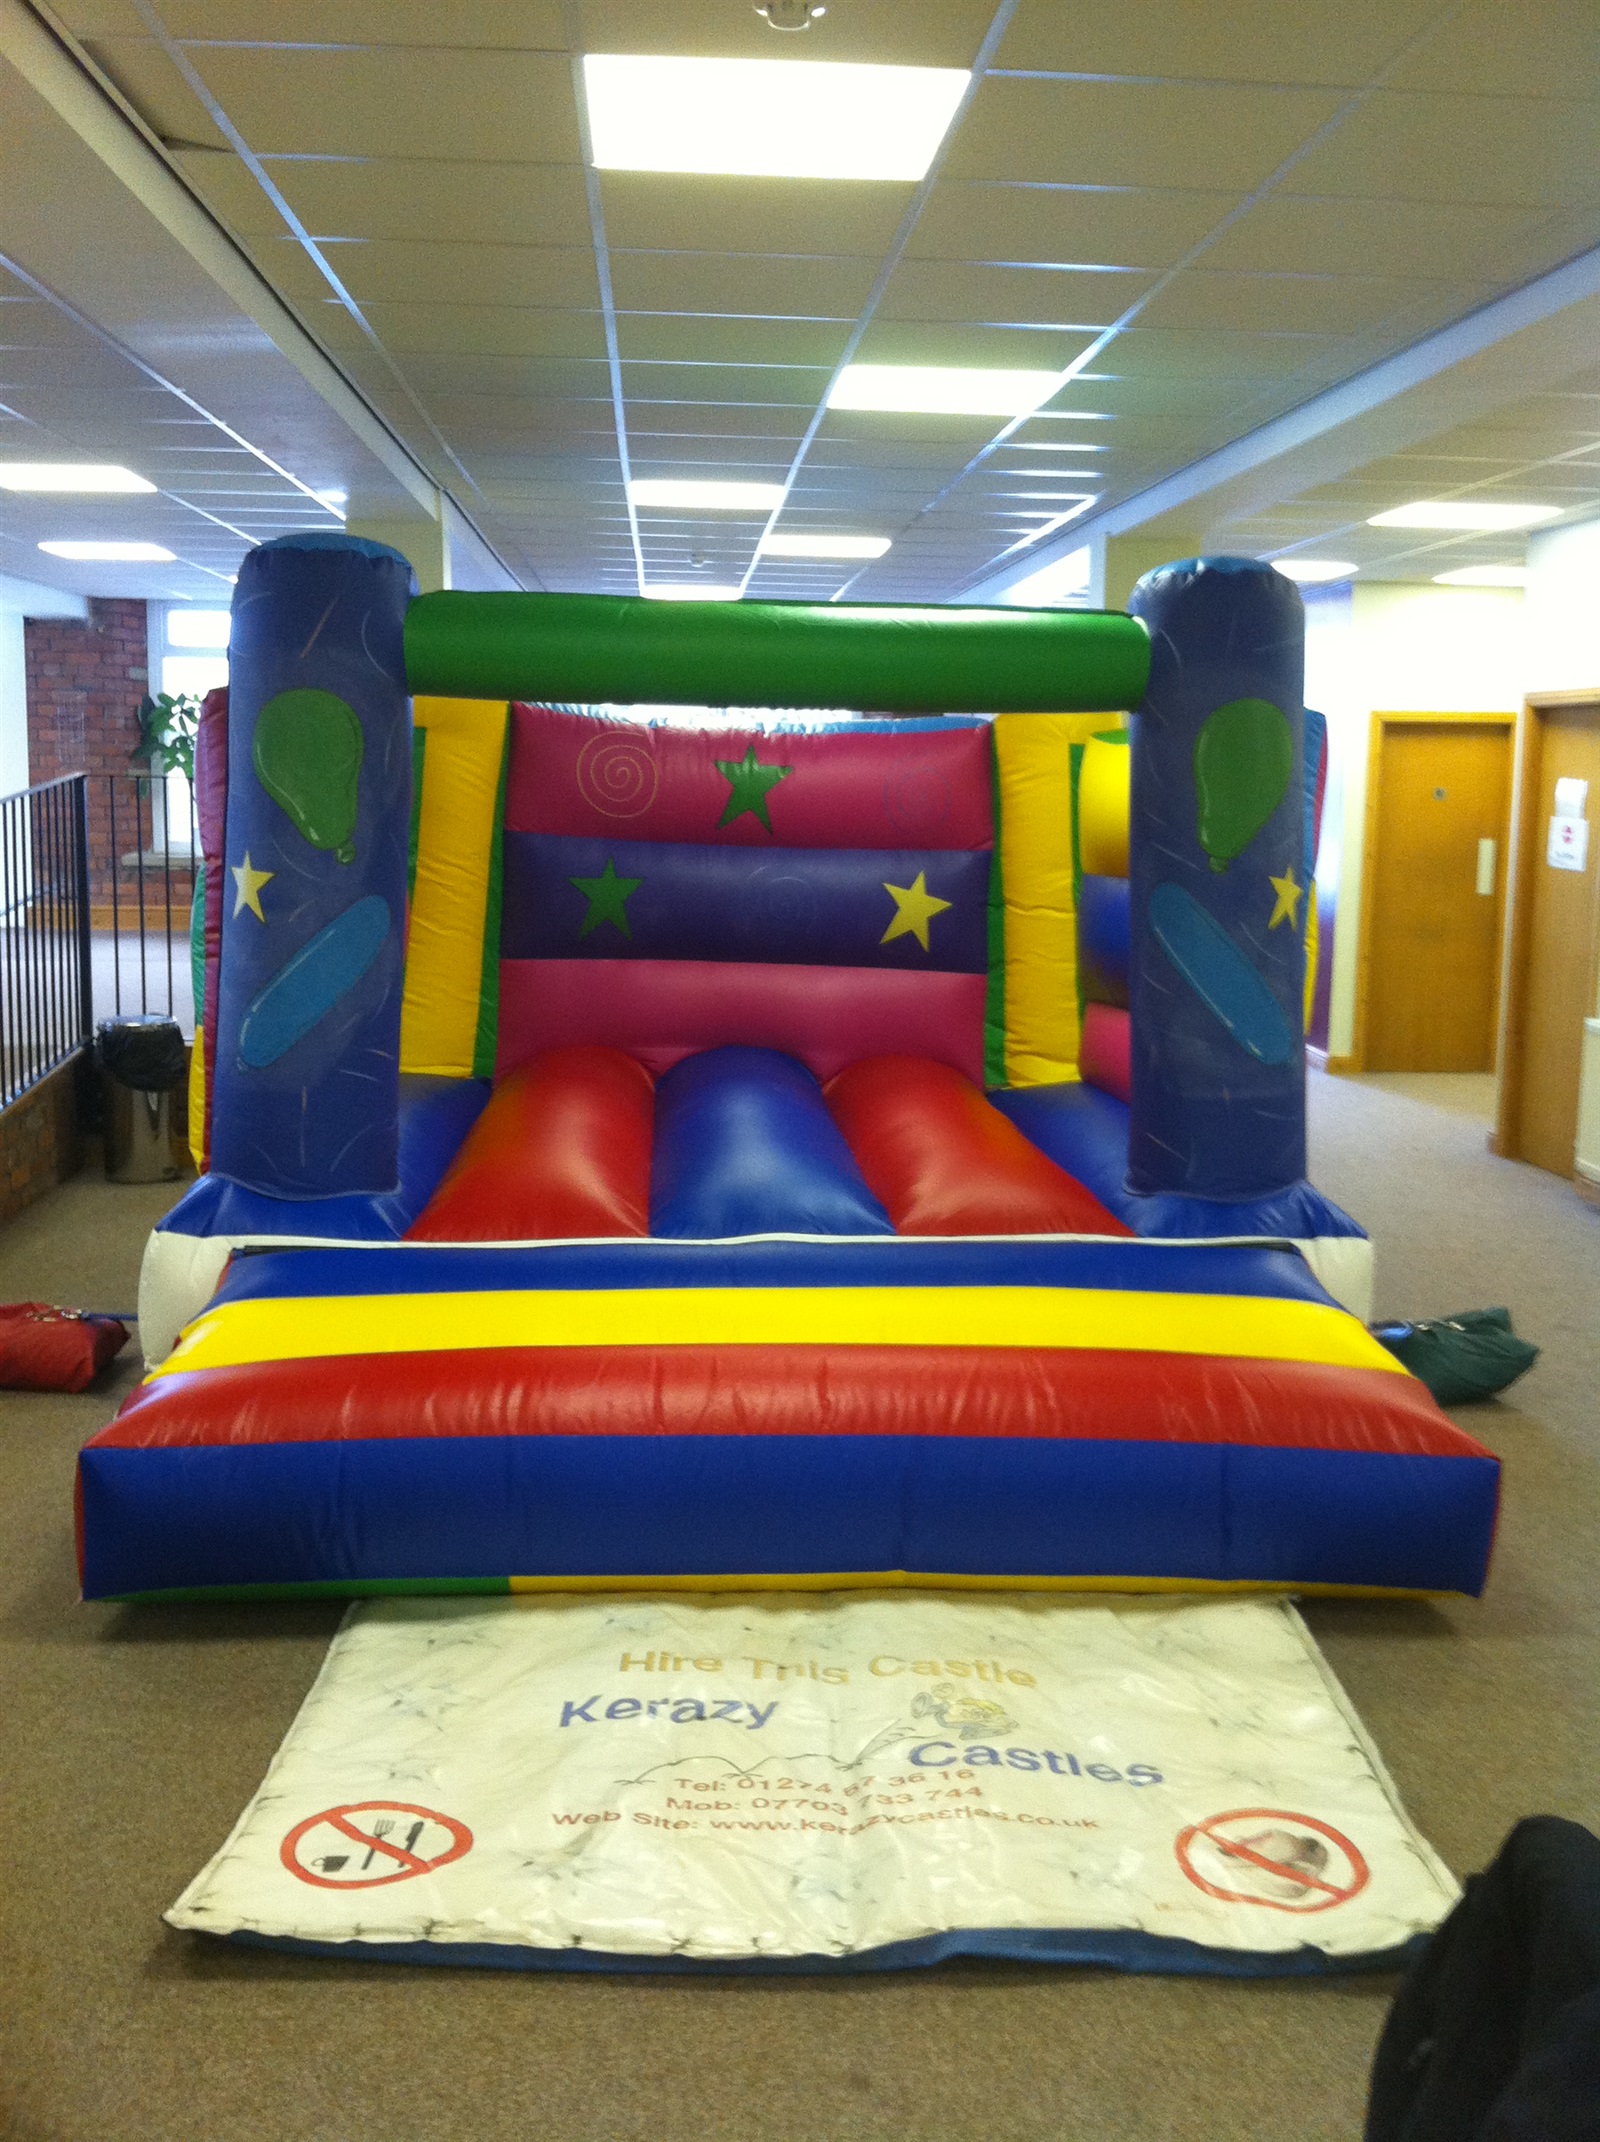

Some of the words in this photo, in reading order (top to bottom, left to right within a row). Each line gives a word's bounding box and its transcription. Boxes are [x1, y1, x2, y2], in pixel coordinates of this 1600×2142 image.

[619, 1651, 723, 1672] Hire
[868, 1655, 1037, 1688] Castle
[559, 1694, 779, 1730] Kerazy
[908, 1741, 1165, 1786] Castles
[674, 1778, 726, 1792] Tel:
[737, 1778, 832, 1793] 01274
[888, 1772, 926, 1787] 36
[938, 1769, 975, 1782] 16
[552, 1810, 621, 1826] Web
[633, 1811, 699, 1830] Site:
[666, 1797, 740, 1811] Mob:
[752, 1798, 849, 1816] 07703
